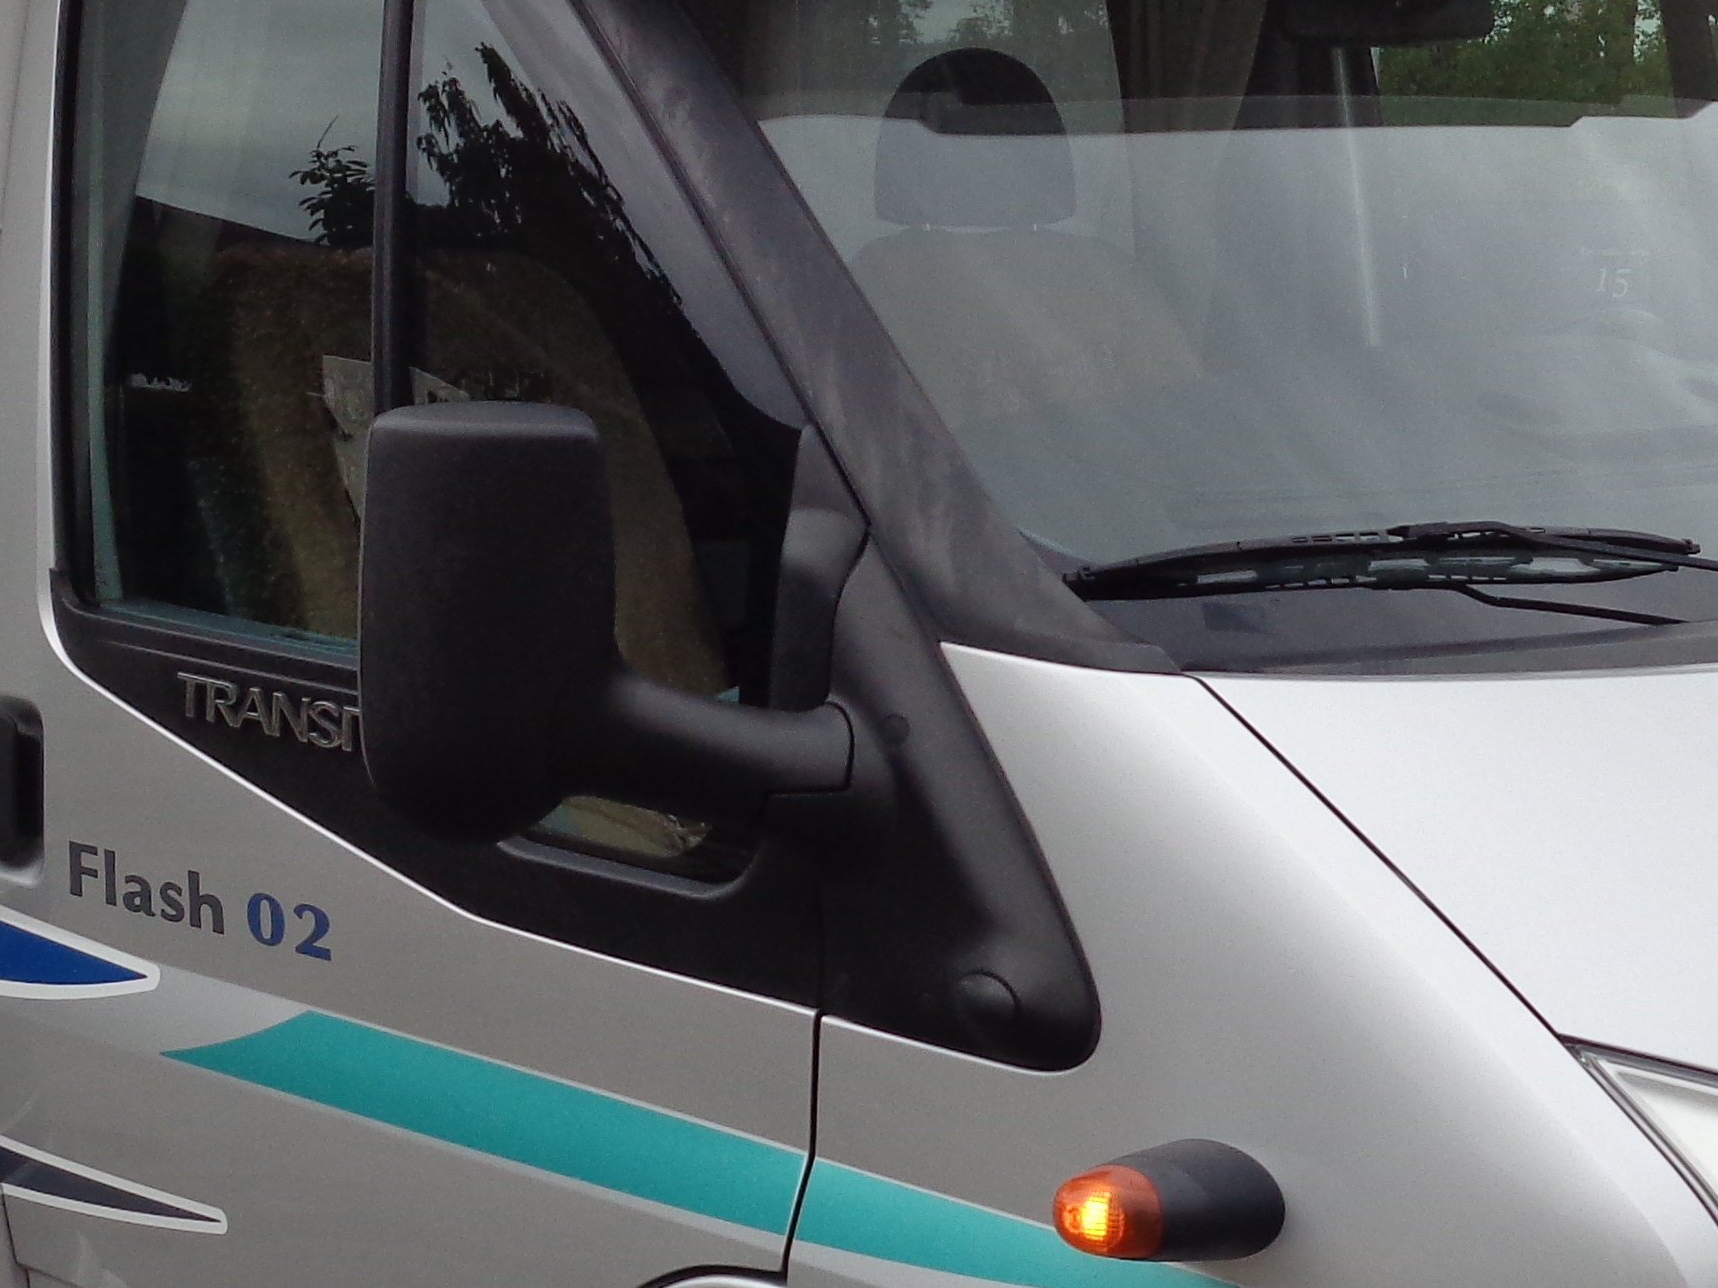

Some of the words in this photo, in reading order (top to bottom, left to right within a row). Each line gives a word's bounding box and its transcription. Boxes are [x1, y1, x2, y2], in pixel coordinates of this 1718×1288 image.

[177, 671, 361, 752] TRANSI
[68, 840, 225, 935] Flash
[246, 892, 332, 962] 02
